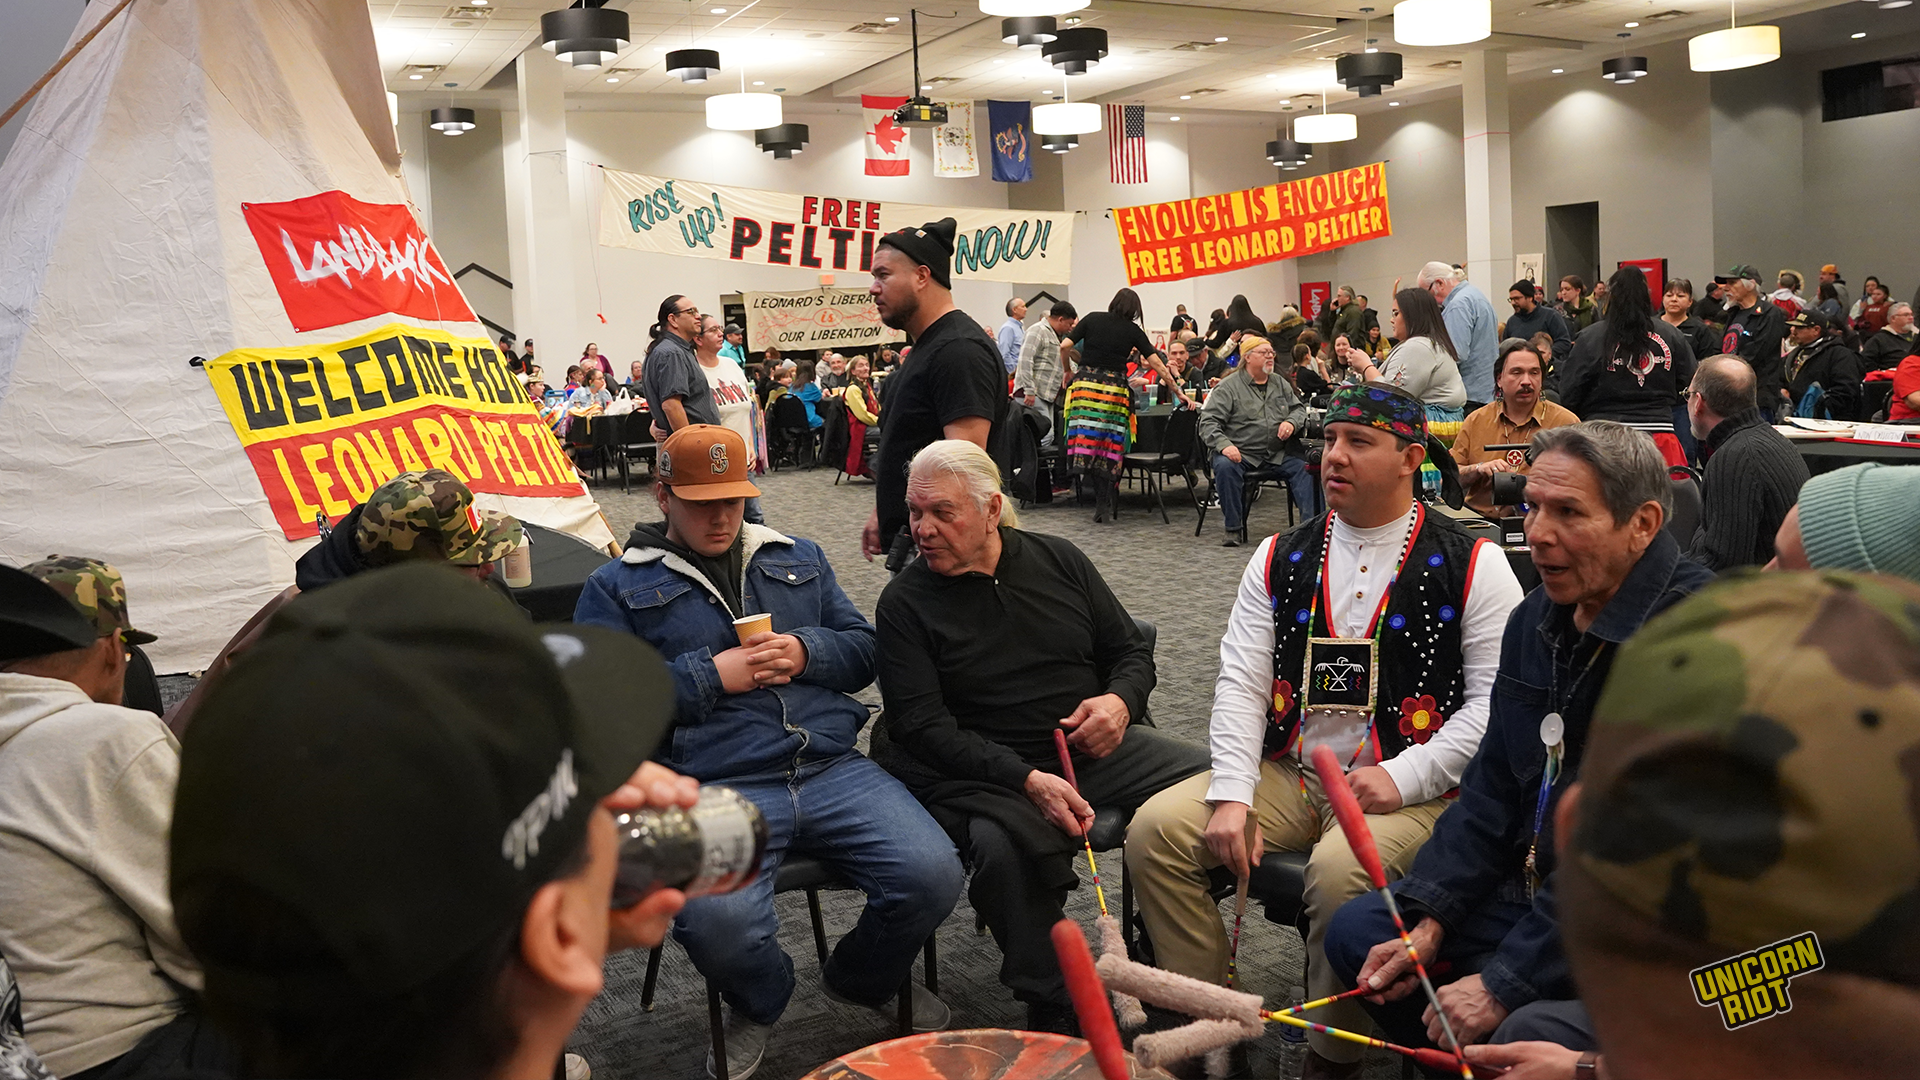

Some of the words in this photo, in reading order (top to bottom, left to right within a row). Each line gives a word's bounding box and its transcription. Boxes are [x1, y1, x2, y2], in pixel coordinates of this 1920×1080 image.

[628, 180, 684, 233] RISE
[679, 192, 727, 249] UP!
[802, 196, 881, 230] FREE
[1118, 193, 1236, 244] ENOUGH
[1242, 189, 1269, 226] IS
[1276, 164, 1385, 219] ENOUGH
[729, 217, 875, 272] PELTI
[955, 219, 1052, 275] NOW!
[1127, 247, 1184, 279] FREE
[1191, 226, 1295, 270] LEONARD
[1304, 206, 1383, 248] PELTIER
[753, 296, 824, 309] LEONARD'S
[830, 295, 877, 306] LIBERA
[820, 311, 834, 323] is
[778, 332, 804, 342] OUR
[810, 327, 881, 341] LIBERATION
[229, 335, 468, 430] WELCOME
[272, 413, 483, 524] LEONARD
[472, 415, 579, 487] PELTIE
